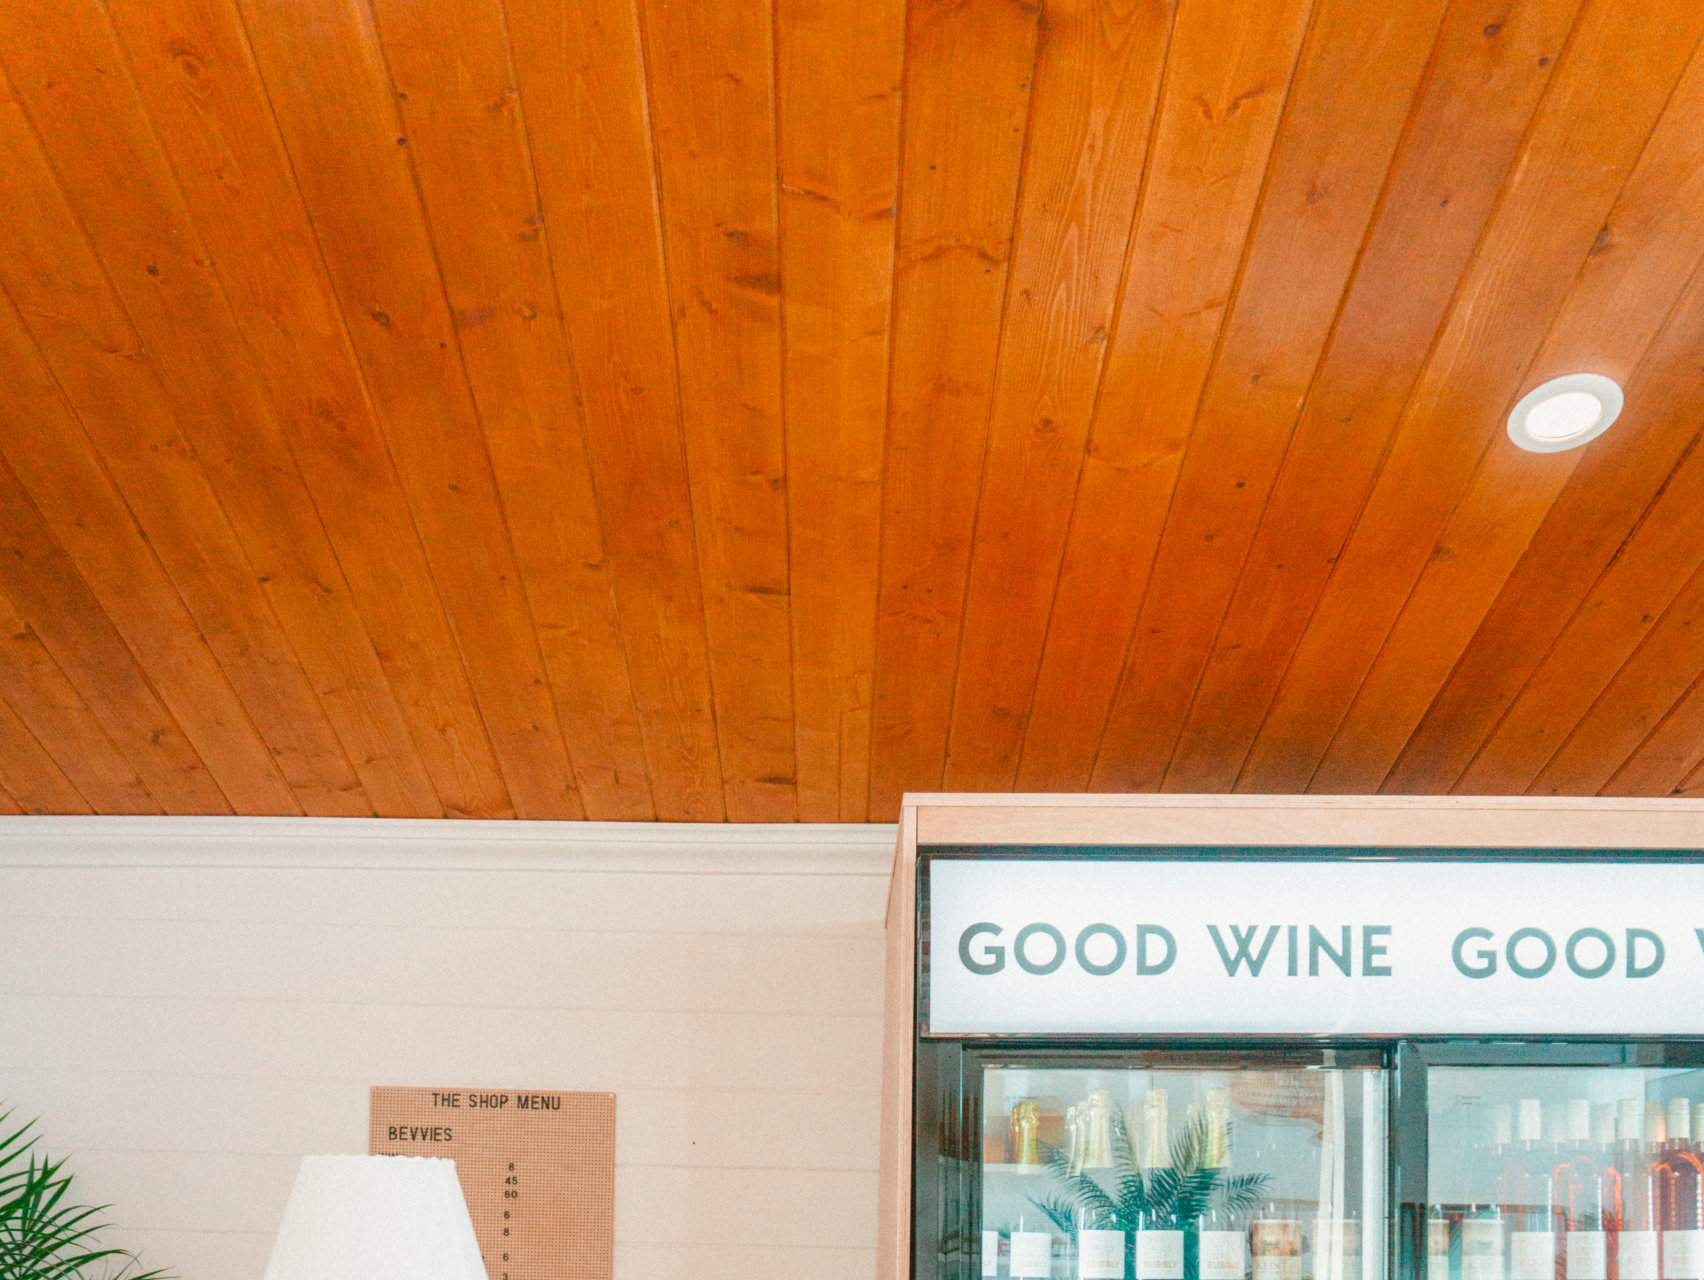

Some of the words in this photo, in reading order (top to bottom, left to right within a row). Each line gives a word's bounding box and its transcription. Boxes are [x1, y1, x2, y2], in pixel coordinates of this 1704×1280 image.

[958, 922, 1177, 977] GOOD
[1206, 924, 1393, 978] WINE
[1451, 927, 1666, 979] GOOD
[432, 1093, 461, 1107] THE
[469, 1094, 509, 1109] SHOP
[517, 1095, 561, 1110] MENU
[388, 1126, 453, 1141] BEVVIES
[504, 1176, 518, 1185] 45
[502, 1273, 508, 1280] 3
